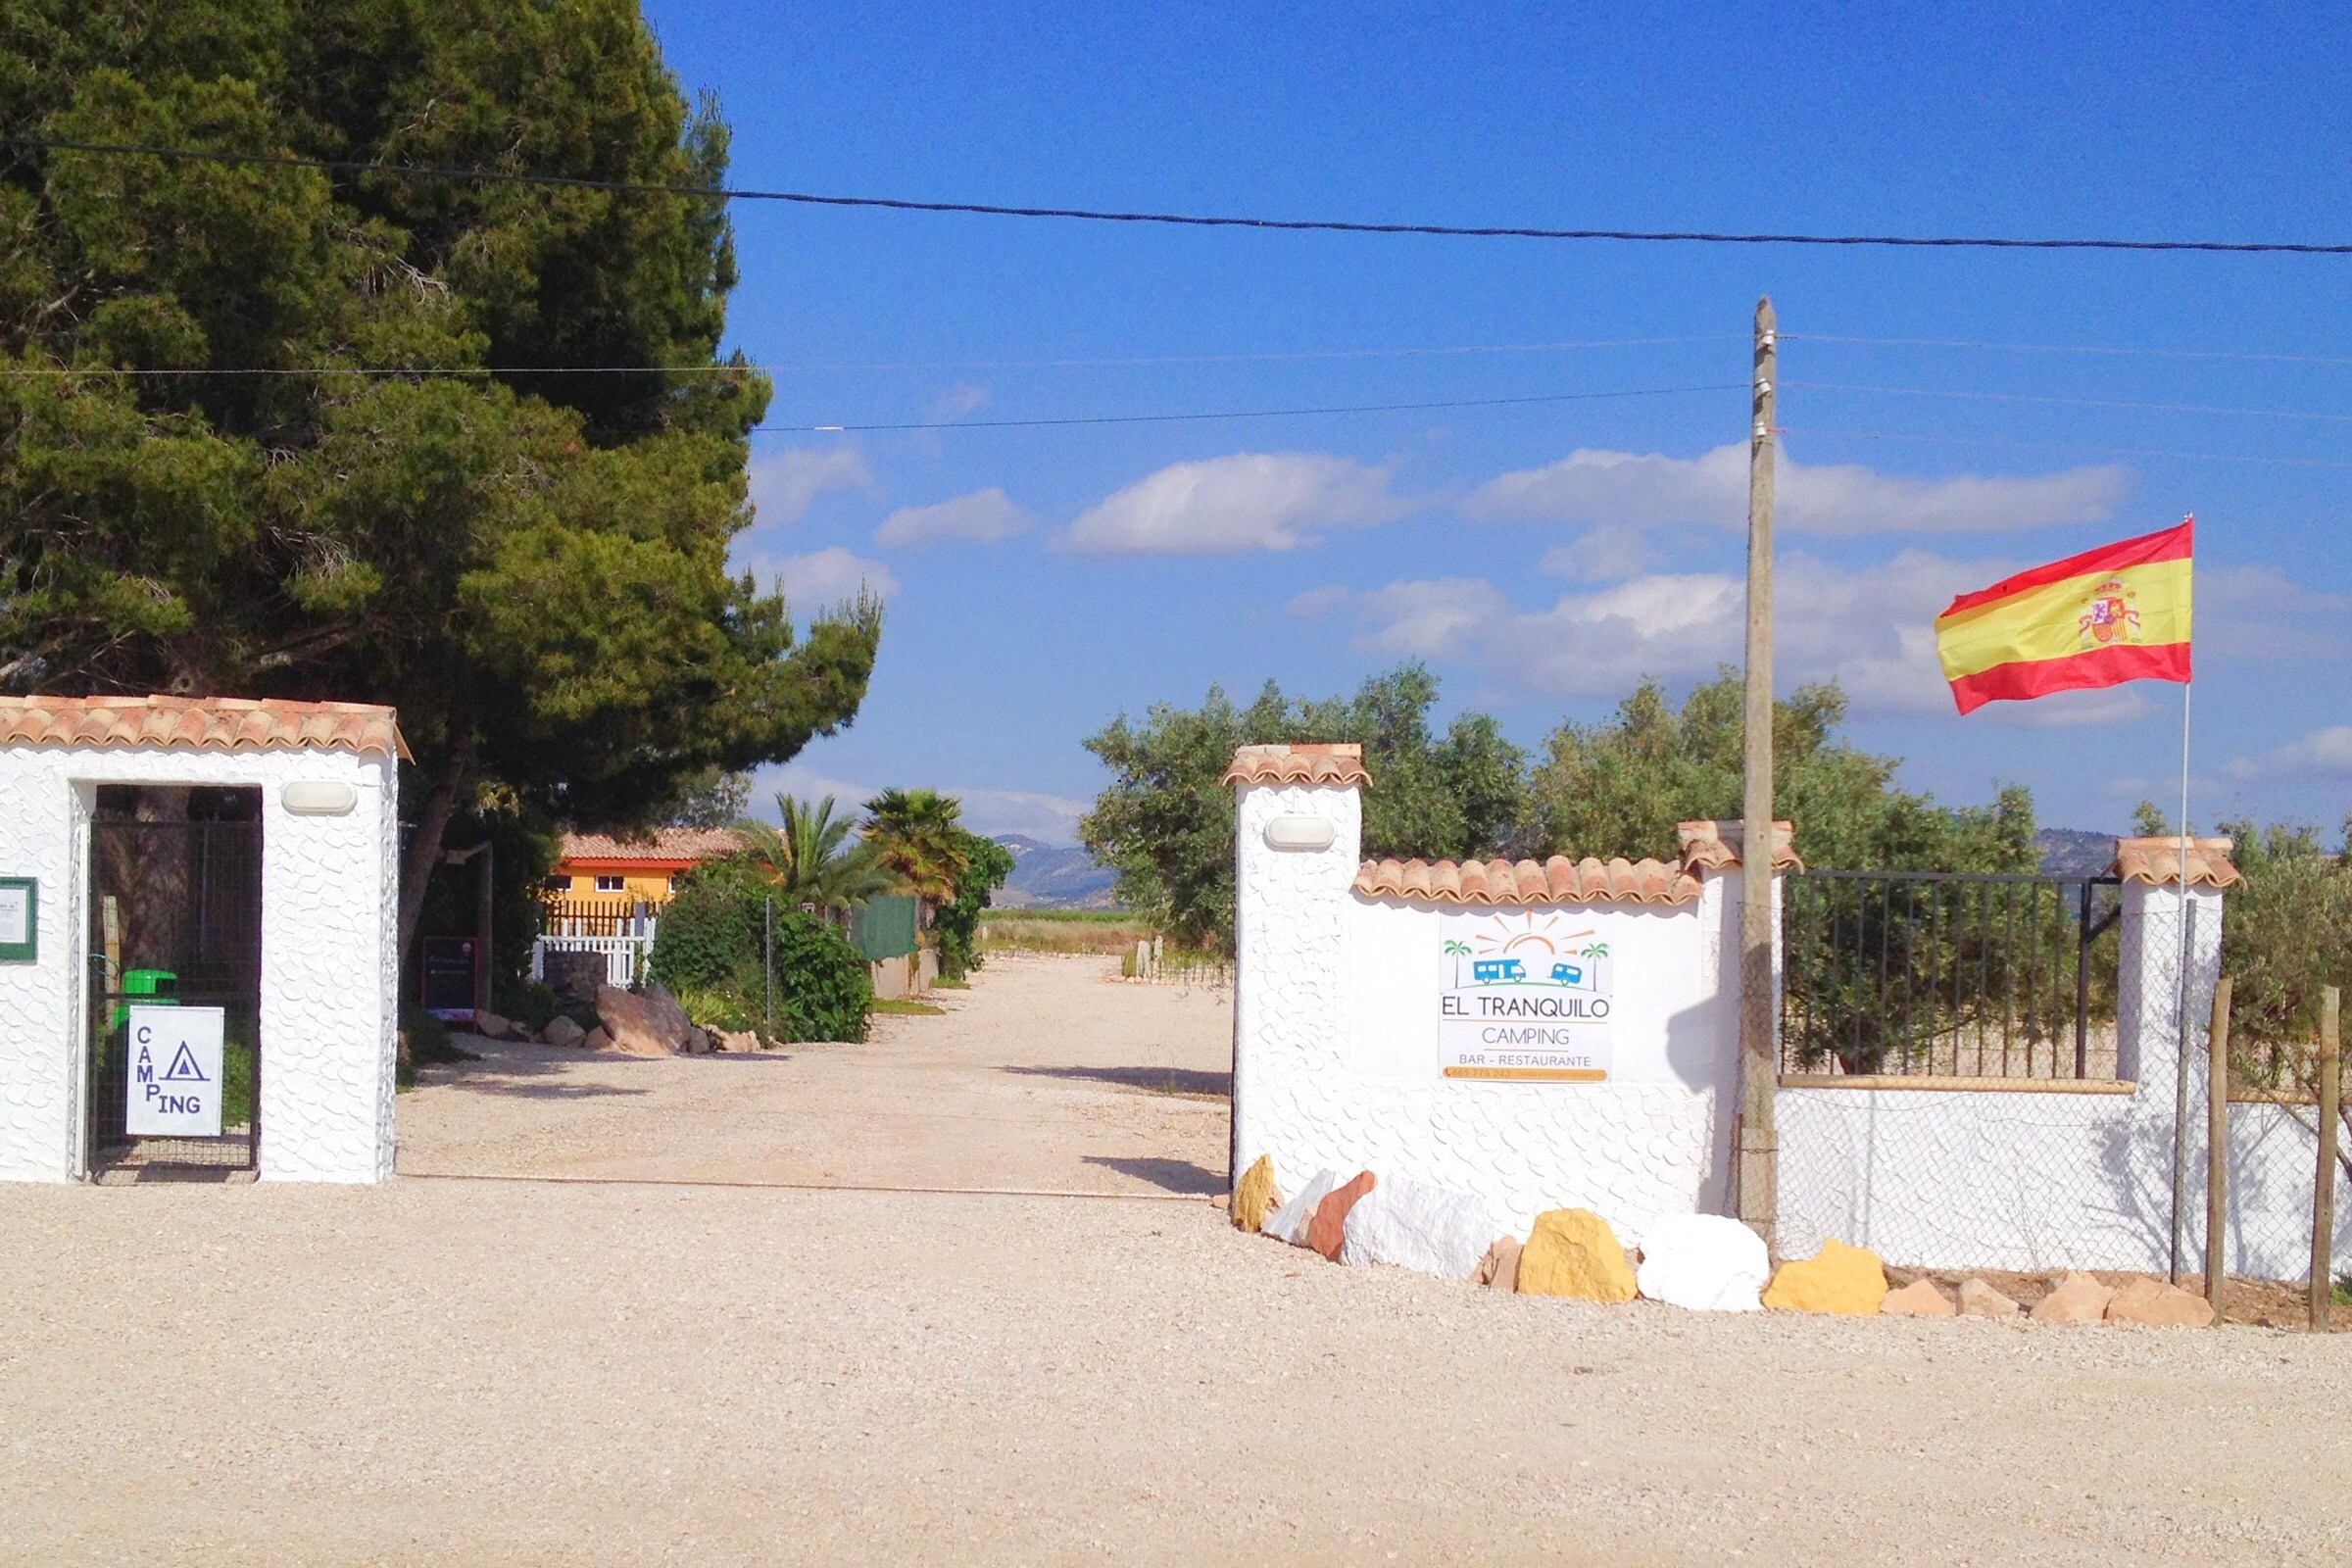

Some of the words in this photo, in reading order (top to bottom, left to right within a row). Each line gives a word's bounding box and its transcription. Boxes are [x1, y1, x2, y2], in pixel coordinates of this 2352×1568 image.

[1443, 996, 1469, 1015] EL
[1478, 997, 1609, 1018] TRANQUILO
[1482, 1027, 1569, 1045] CAMPING
[1459, 1054, 1485, 1065] BAR
[1499, 1054, 1591, 1066] RESTAURANTE
